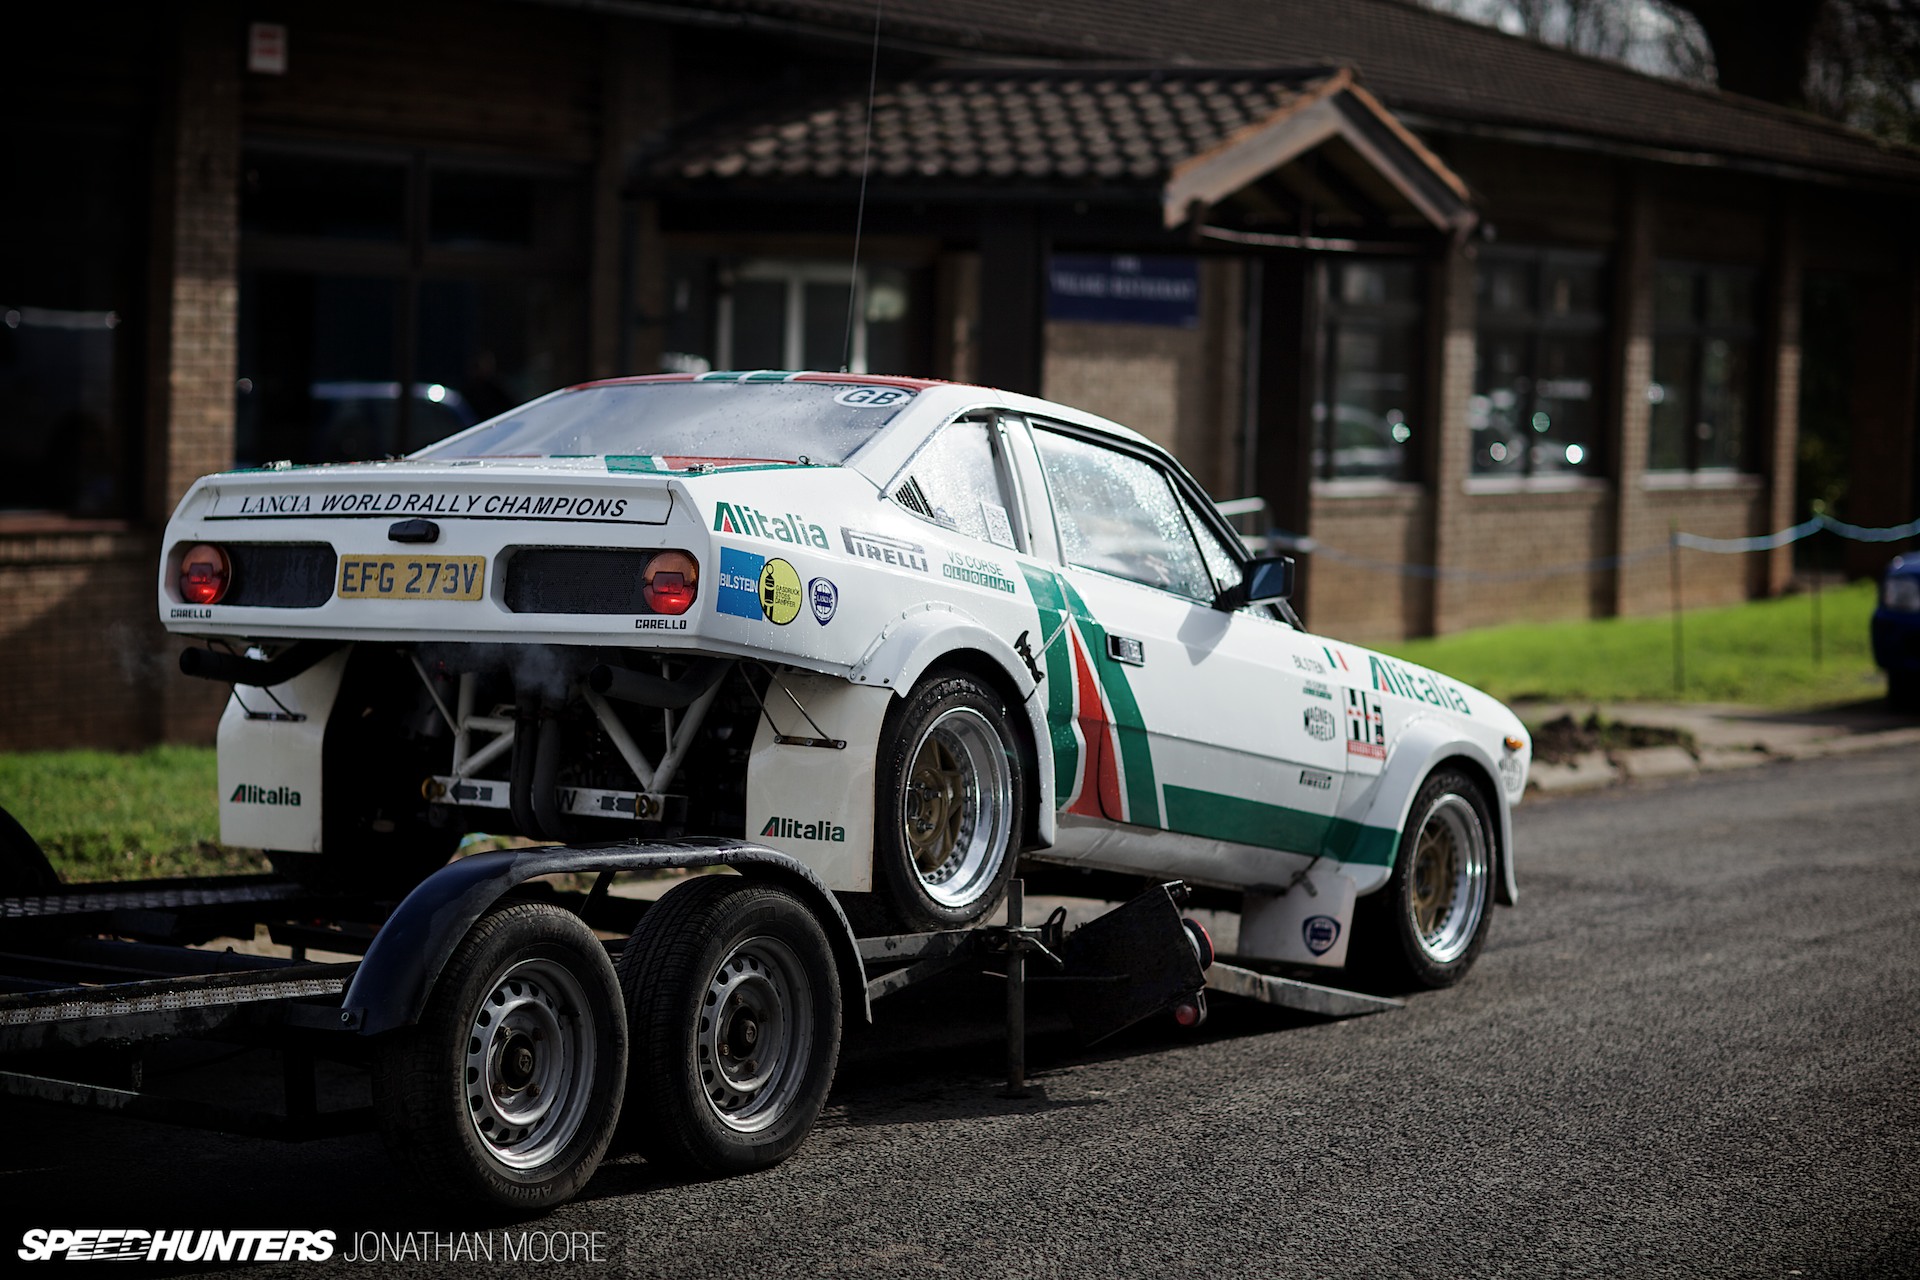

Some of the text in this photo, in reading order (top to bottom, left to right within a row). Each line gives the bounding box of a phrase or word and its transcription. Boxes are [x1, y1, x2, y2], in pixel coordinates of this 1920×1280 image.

[842, 389, 903, 405] GB
[239, 495, 311, 513] LANCIA
[484, 495, 628, 517] CHAMPIONS
[713, 501, 830, 550] Alitalia
[840, 526, 929, 572] PIRELLI
[946, 551, 1004, 577] VS CORSE
[342, 562, 478, 594] EFG 273V
[170, 609, 212, 618] CARELLO
[635, 619, 687, 630] CARELLO
[1368, 655, 1471, 715] Alitalia
[230, 784, 302, 807] Alitalia
[759, 816, 845, 842] Alitalia
